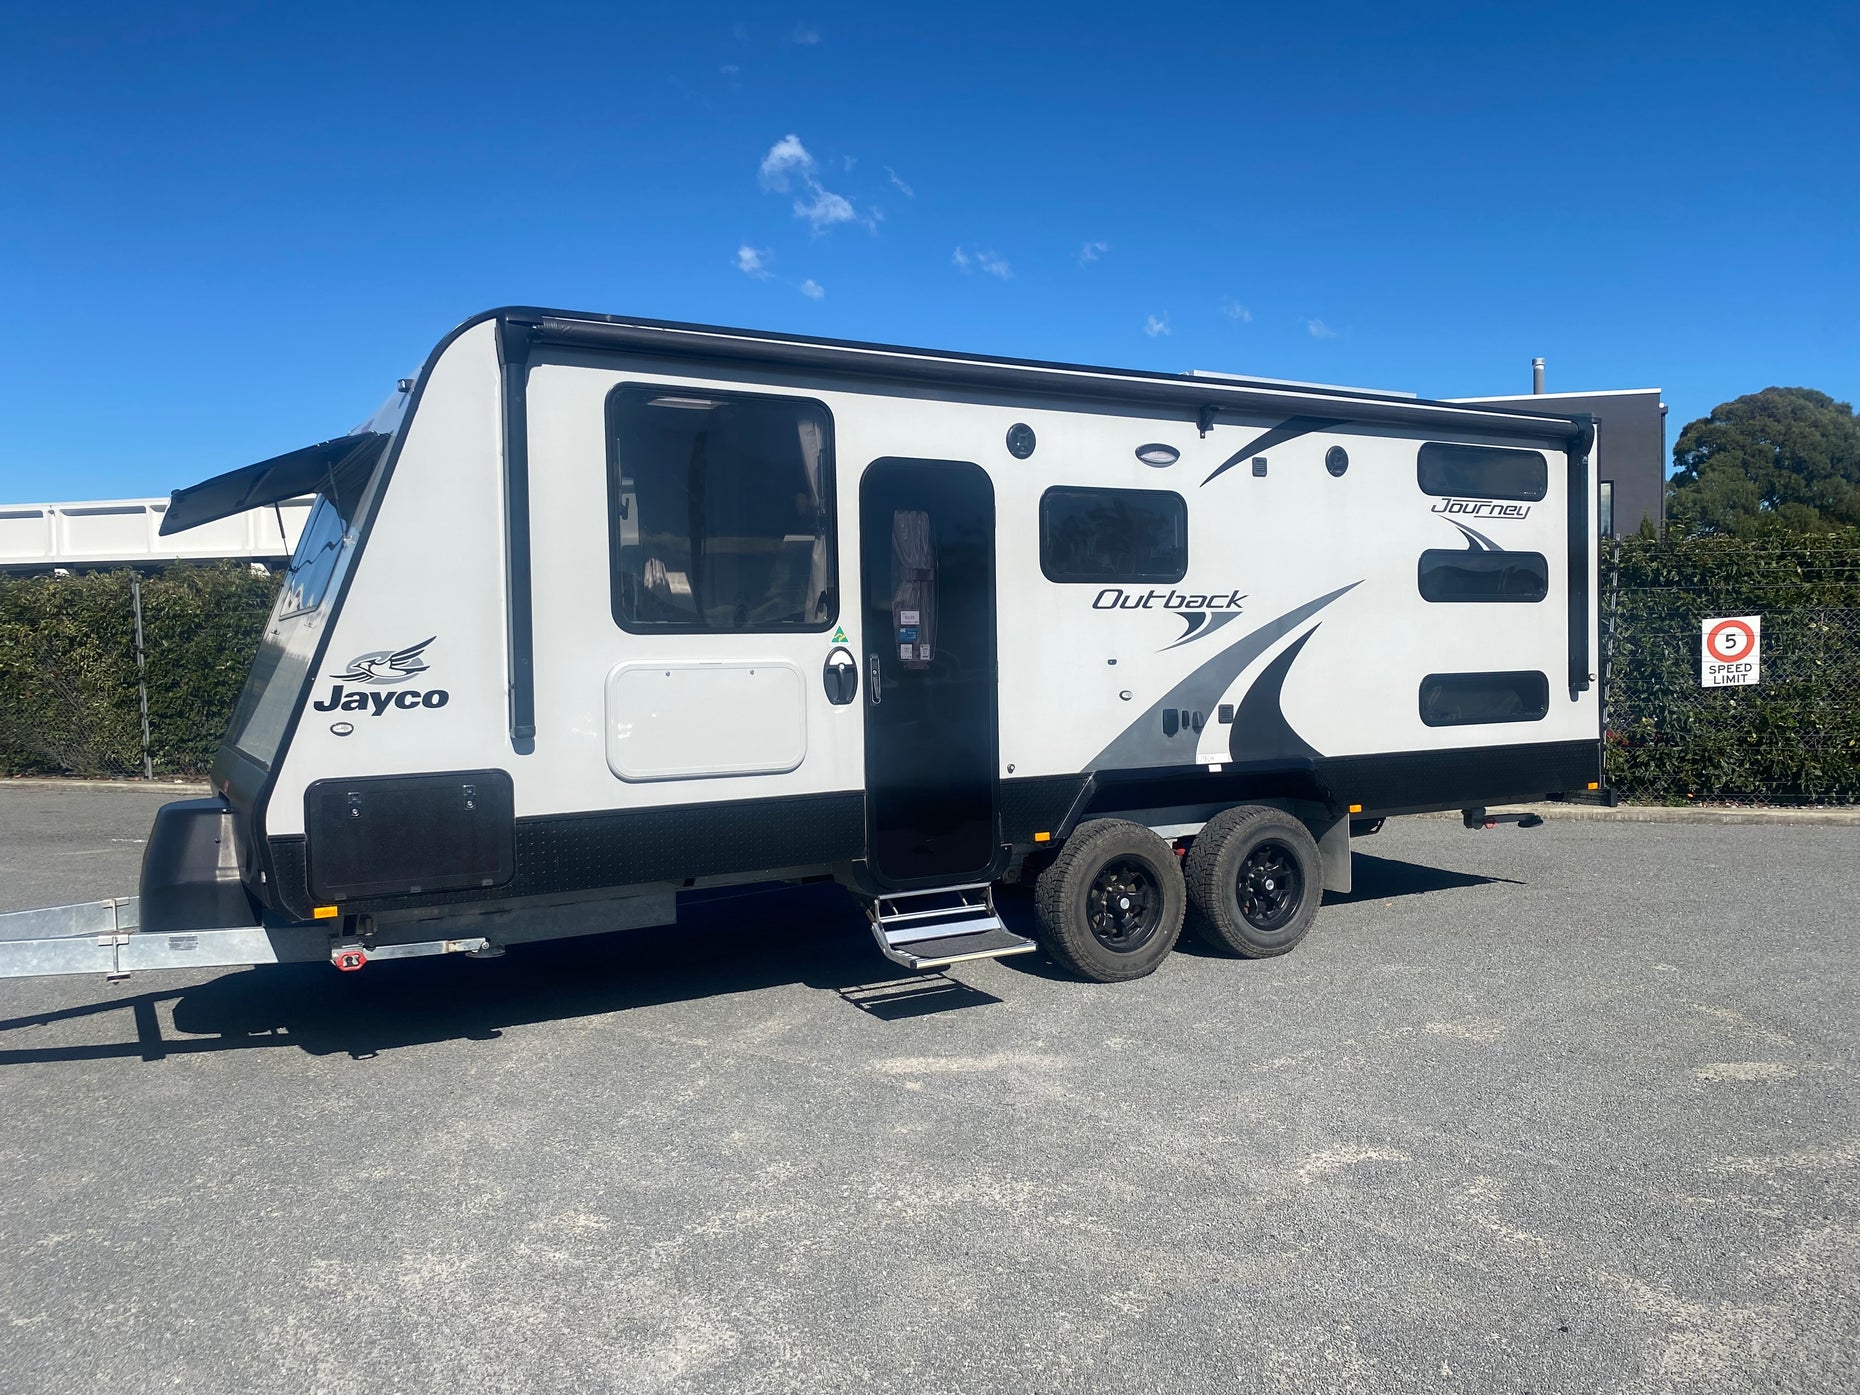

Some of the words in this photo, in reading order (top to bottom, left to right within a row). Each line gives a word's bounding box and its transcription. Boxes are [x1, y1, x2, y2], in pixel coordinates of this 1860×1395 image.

[1431, 498, 1531, 519] Journey
[1092, 589, 1249, 609] Outback
[1725, 633, 1737, 649] 5
[1709, 663, 1753, 674] SPEED
[1713, 674, 1748, 684] LIMIT
[313, 685, 450, 717] Jayco
